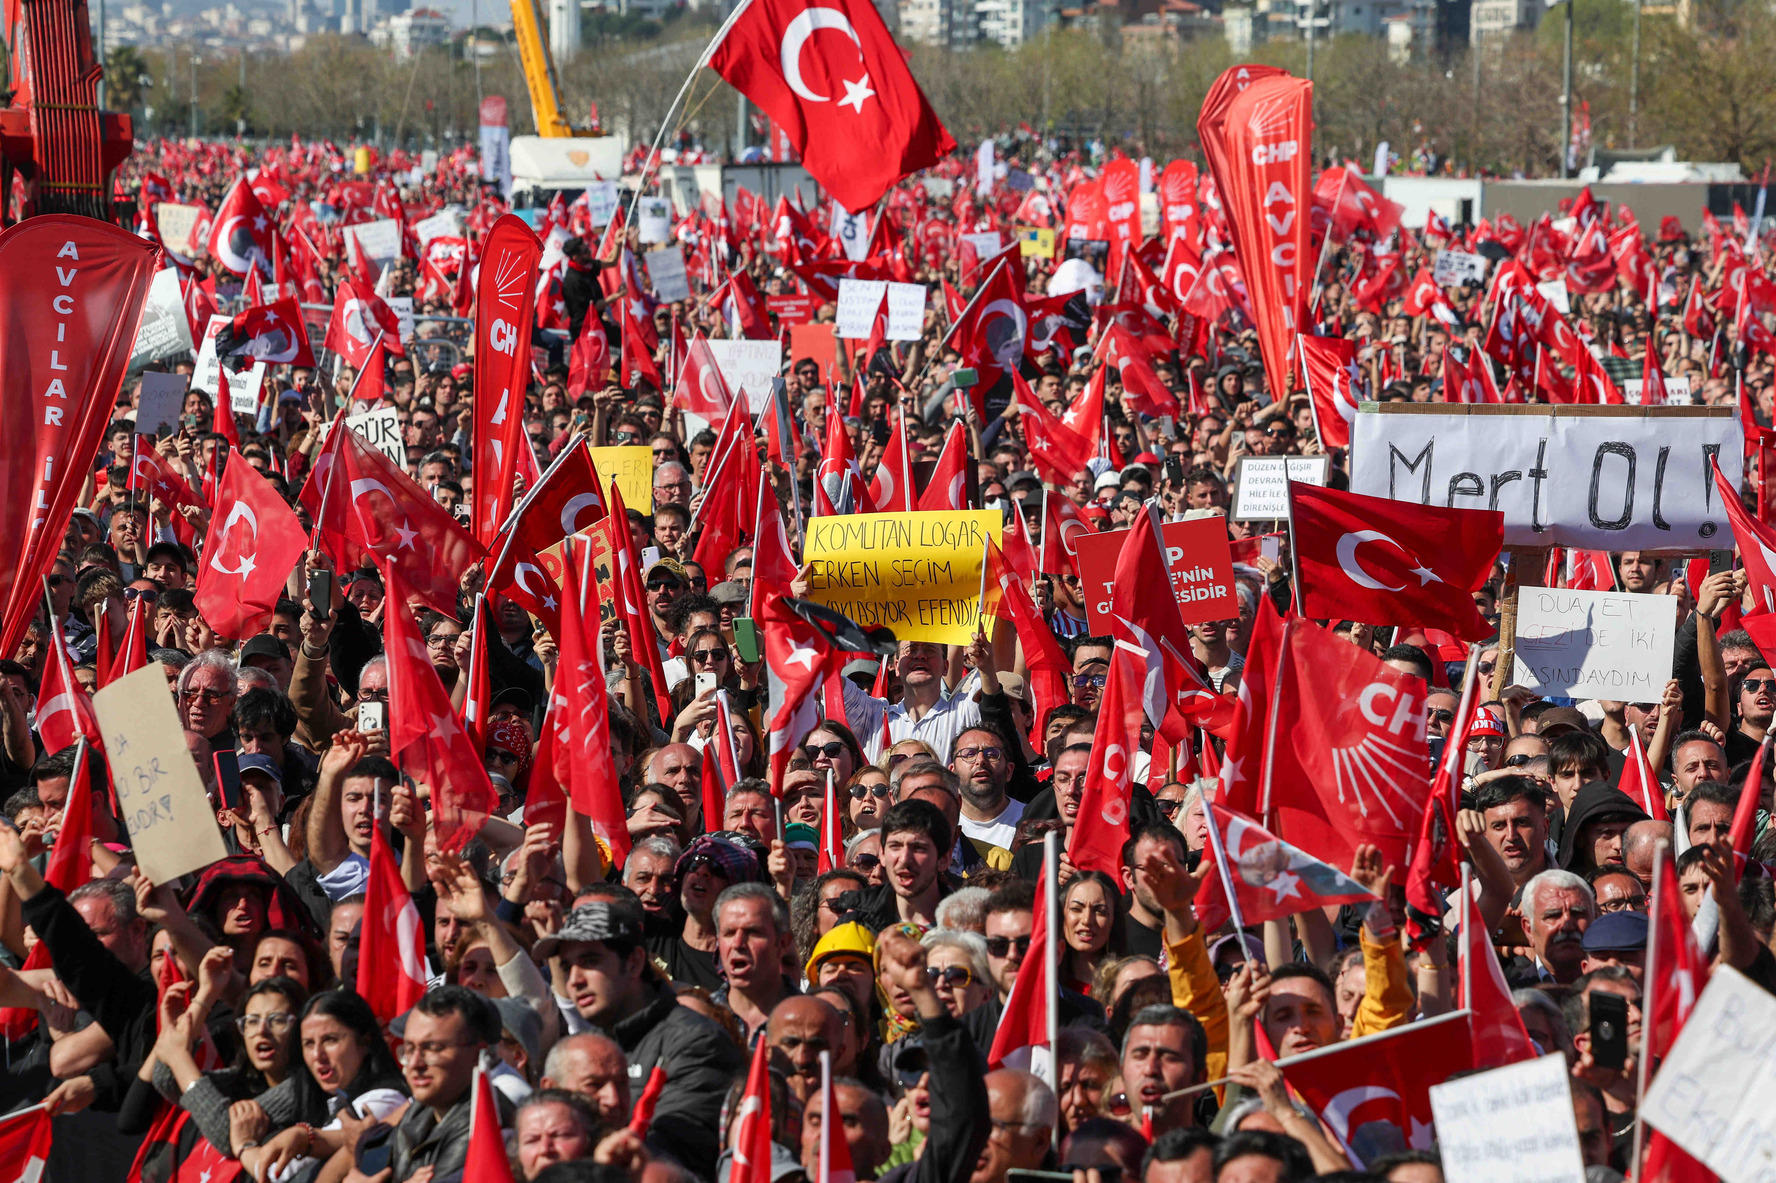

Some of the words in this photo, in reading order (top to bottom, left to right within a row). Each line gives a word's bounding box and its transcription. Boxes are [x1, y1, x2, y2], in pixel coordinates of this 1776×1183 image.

[1252, 140, 1298, 166] CHP
[1263, 181, 1296, 360] AVCIL
[44, 240, 80, 427] AVCILAR
[490, 318, 518, 357] CH
[1248, 463, 1277, 471] DÜZEN
[1248, 477, 1283, 485] DEVRAN
[1249, 489, 1268, 498] HİLE
[1269, 489, 1281, 498] İLE
[1388, 435, 1548, 533] Mert
[1243, 503, 1285, 513] DİRENİŞLE
[814, 520, 912, 552] KOMUTAN
[920, 520, 984, 550] LOGAR
[810, 560, 880, 590] ERKEN
[891, 559, 953, 587] SEÇİM
[814, 599, 913, 627] AKLAŞIYOR
[1538, 593, 1586, 614] DUA
[1602, 598, 1638, 619] ET
[1523, 621, 1610, 647] GEZİ'DE
[1517, 666, 1651, 689] YAŞINDAYDIM
[1359, 682, 1428, 743] CH
[133, 756, 169, 795] BİR
